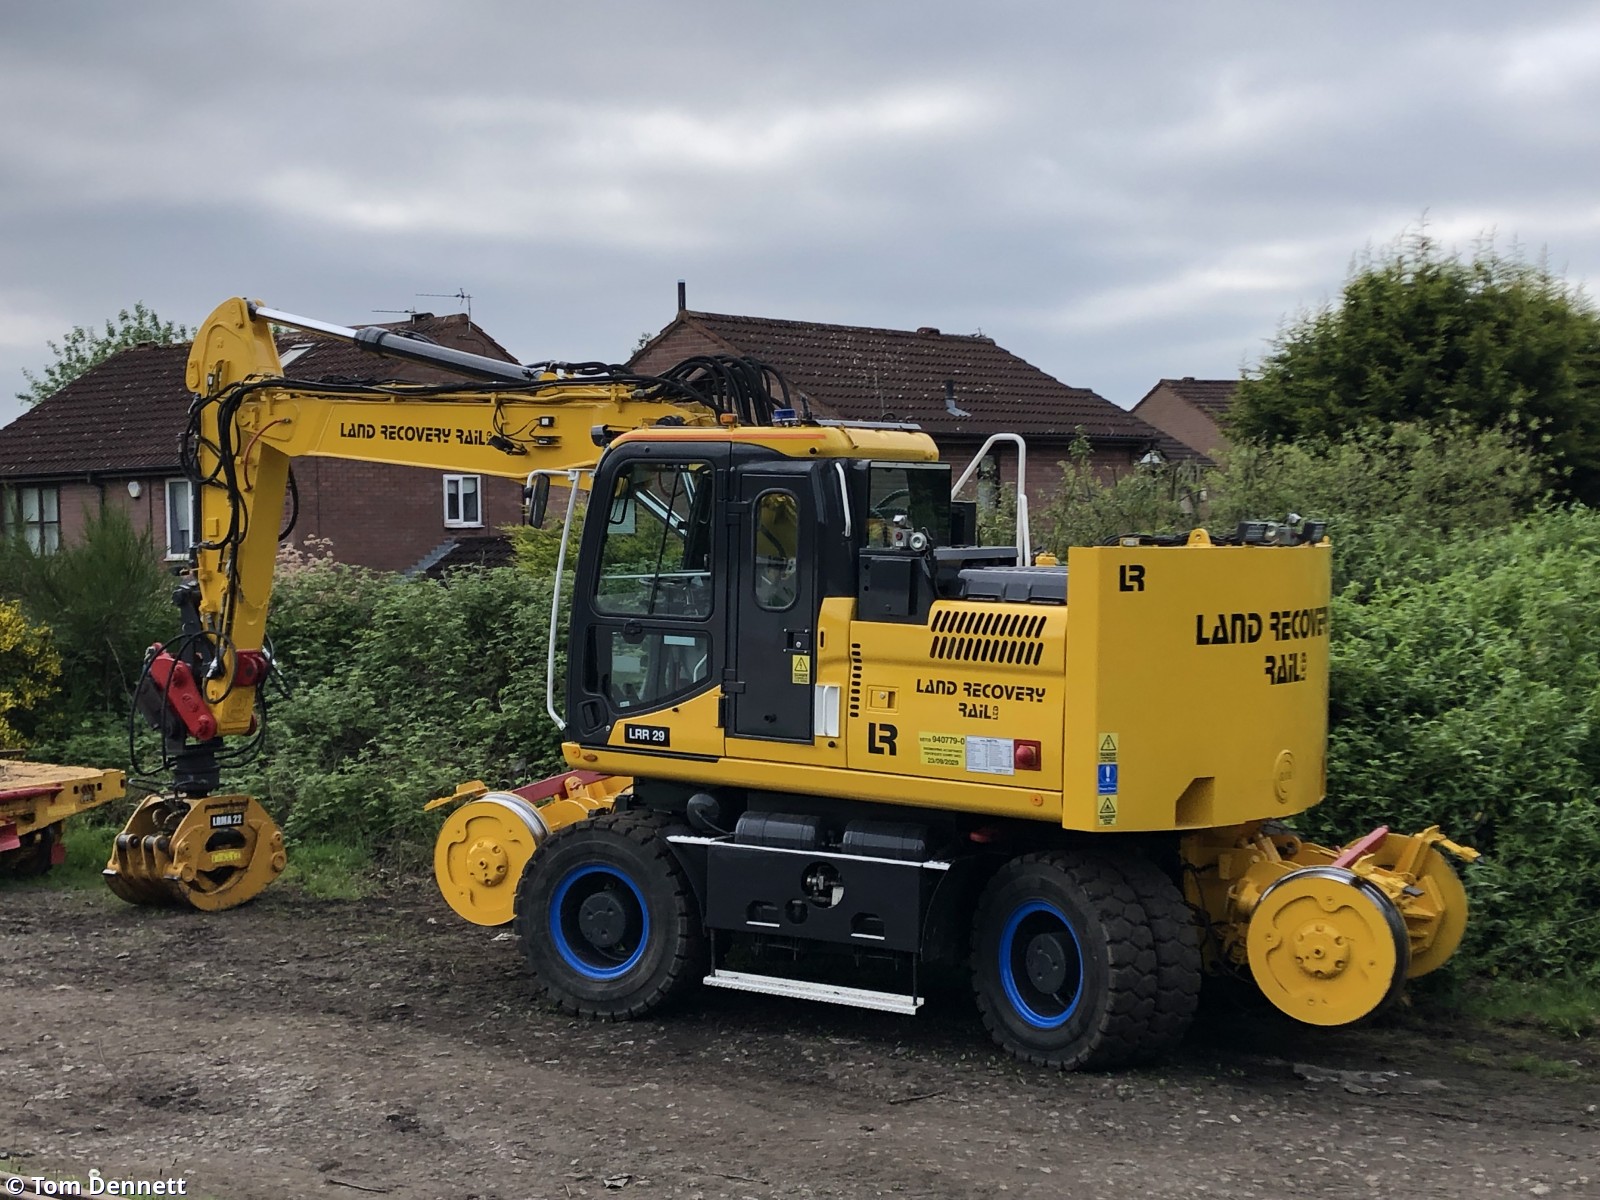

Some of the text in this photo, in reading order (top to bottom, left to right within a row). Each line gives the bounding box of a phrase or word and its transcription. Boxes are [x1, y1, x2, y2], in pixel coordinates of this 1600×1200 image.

[340, 422, 376, 439] LAND
[380, 424, 451, 443] RECOVERY
[1119, 564, 1146, 592] LR
[1196, 613, 1263, 645] LAND
[916, 678, 1046, 703] LAND RECOVERY
[629, 727, 665, 742] LRR 29
[868, 722, 899, 756] LR
[233, 814, 242, 824] 22
